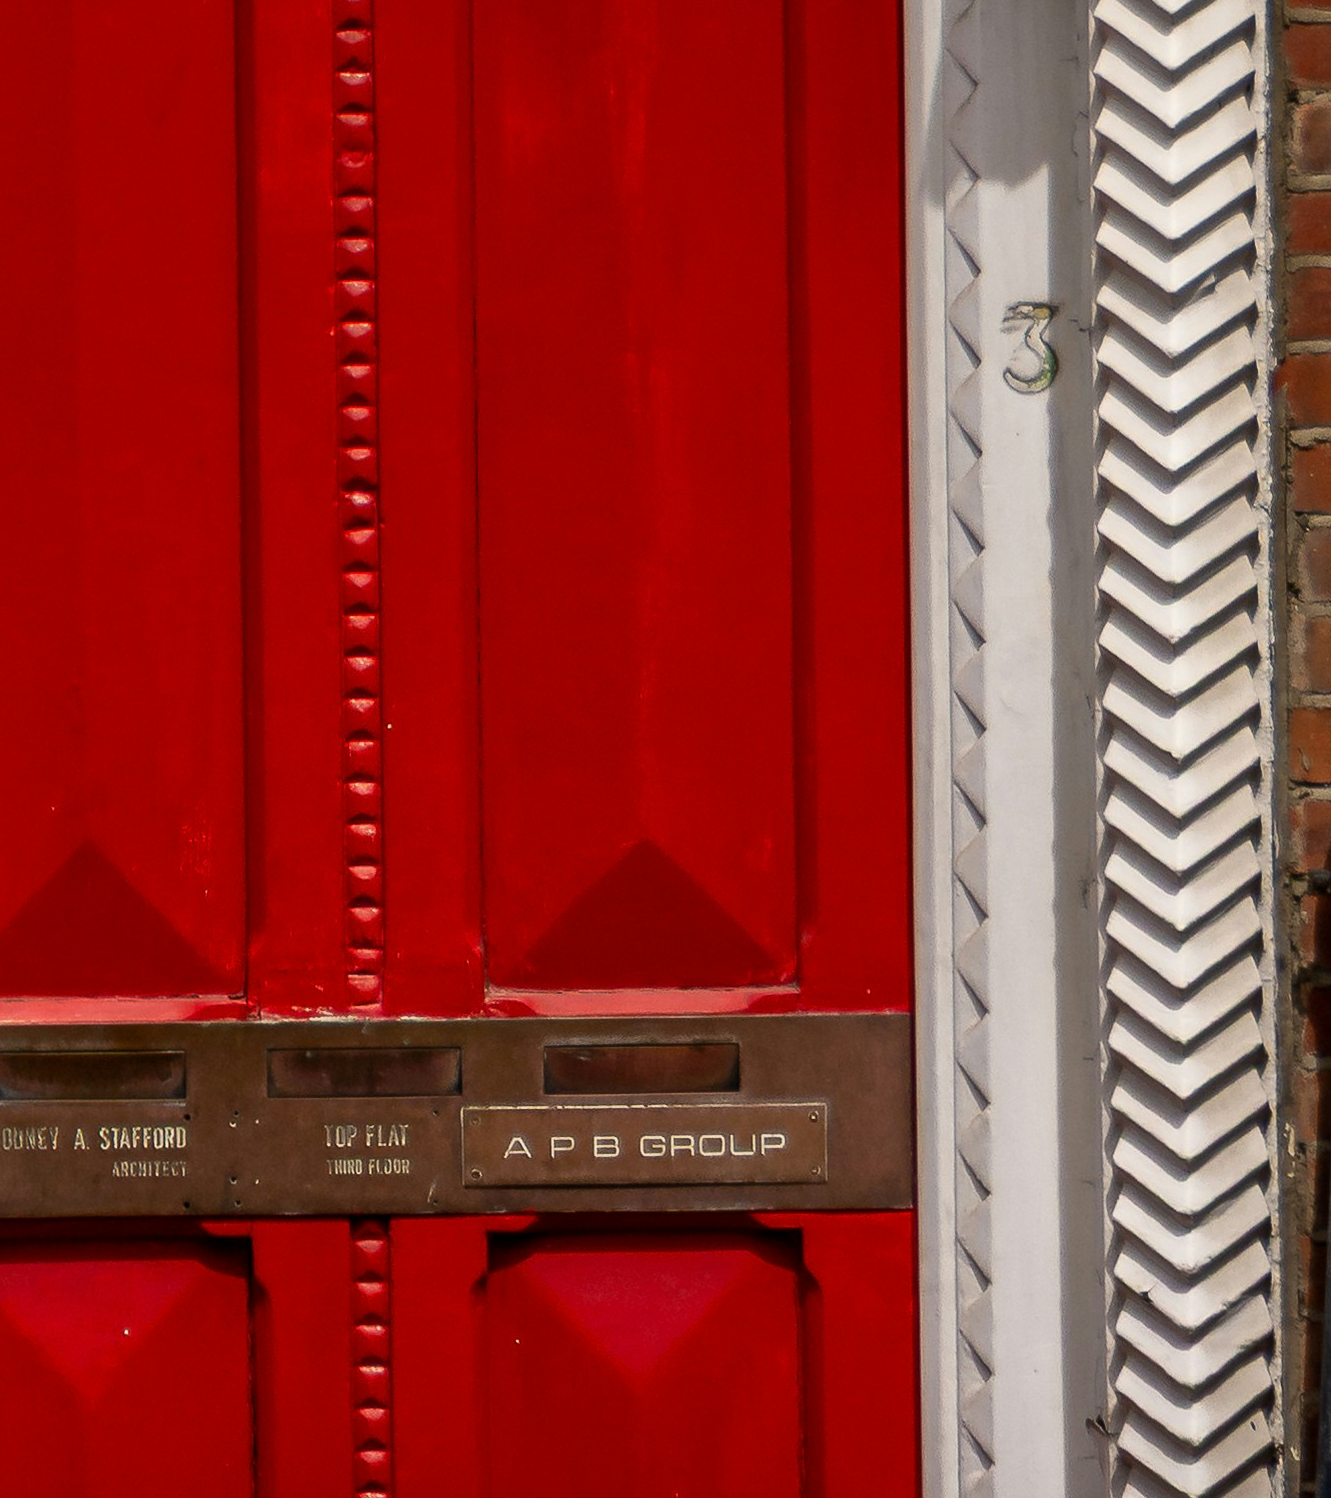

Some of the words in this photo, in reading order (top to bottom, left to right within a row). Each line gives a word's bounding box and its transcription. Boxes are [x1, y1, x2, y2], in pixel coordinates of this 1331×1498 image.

[1001, 300, 1059, 395] 3
[73, 1127, 90, 1151] A.
[99, 1125, 187, 1151] STAFFORD
[324, 1123, 358, 1148] TOP
[365, 1123, 410, 1148] FLAT
[502, 1136, 532, 1159] A
[550, 1135, 576, 1159] P
[592, 1135, 621, 1158] B
[639, 1132, 786, 1158] GROUP
[111, 1160, 187, 1178] ARCHITECT
[326, 1158, 363, 1175] THIRD
[367, 1158, 411, 1175] FLOOR
